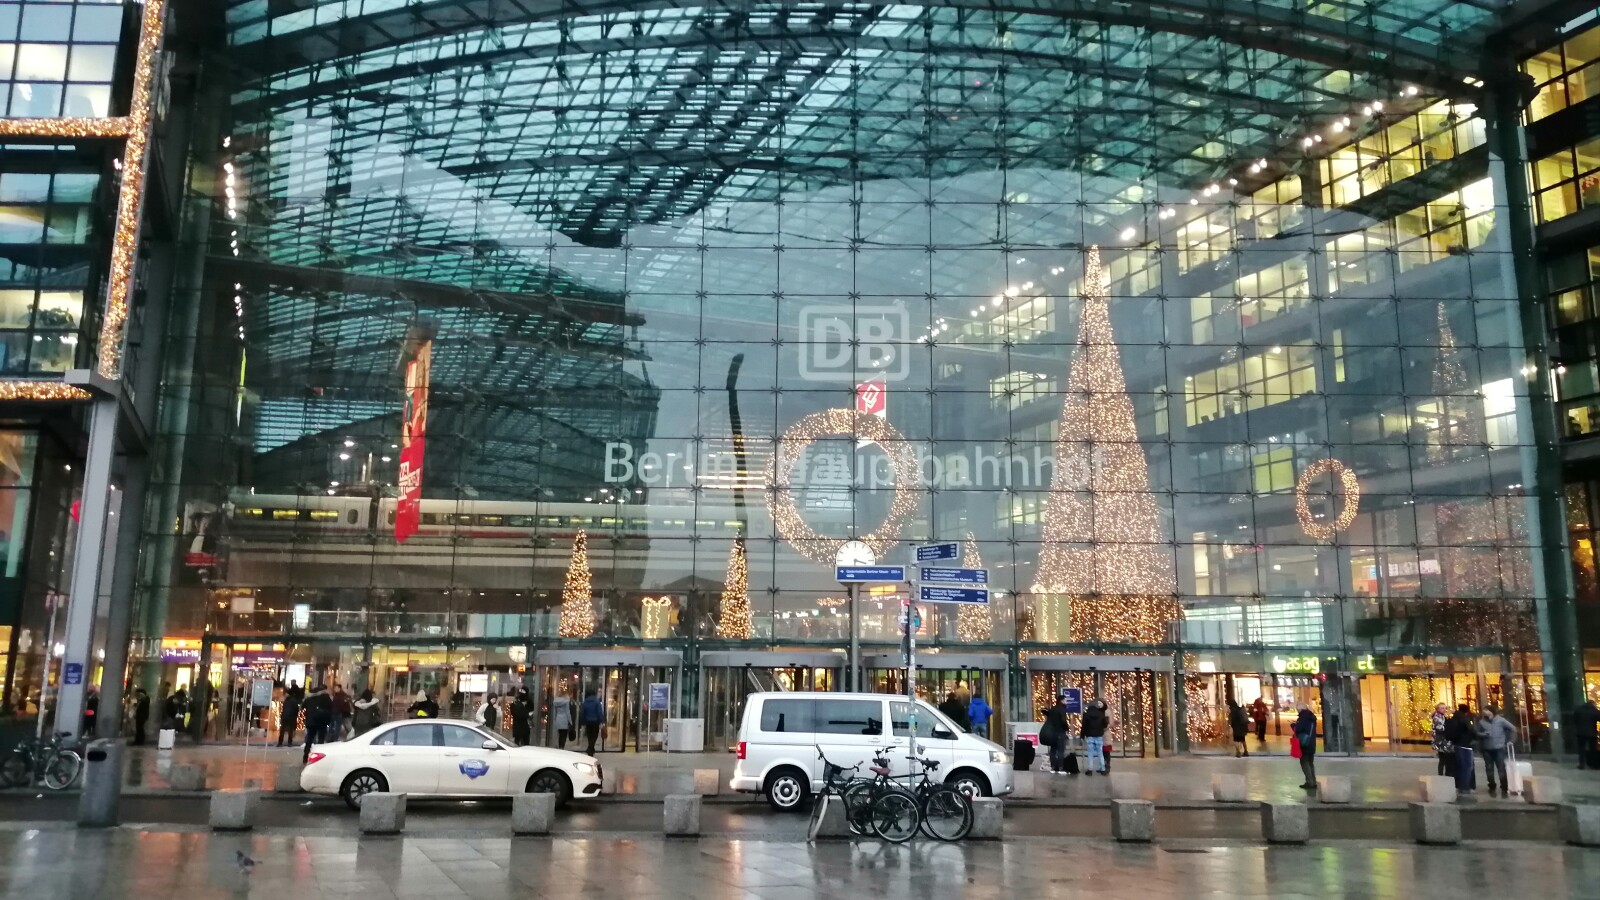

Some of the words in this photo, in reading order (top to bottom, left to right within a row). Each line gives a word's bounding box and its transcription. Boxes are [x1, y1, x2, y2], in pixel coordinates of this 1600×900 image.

[812, 316, 897, 370] DB
[604, 442, 737, 484] Berlin
[777, 443, 1106, 495] Hauptbahnhof
